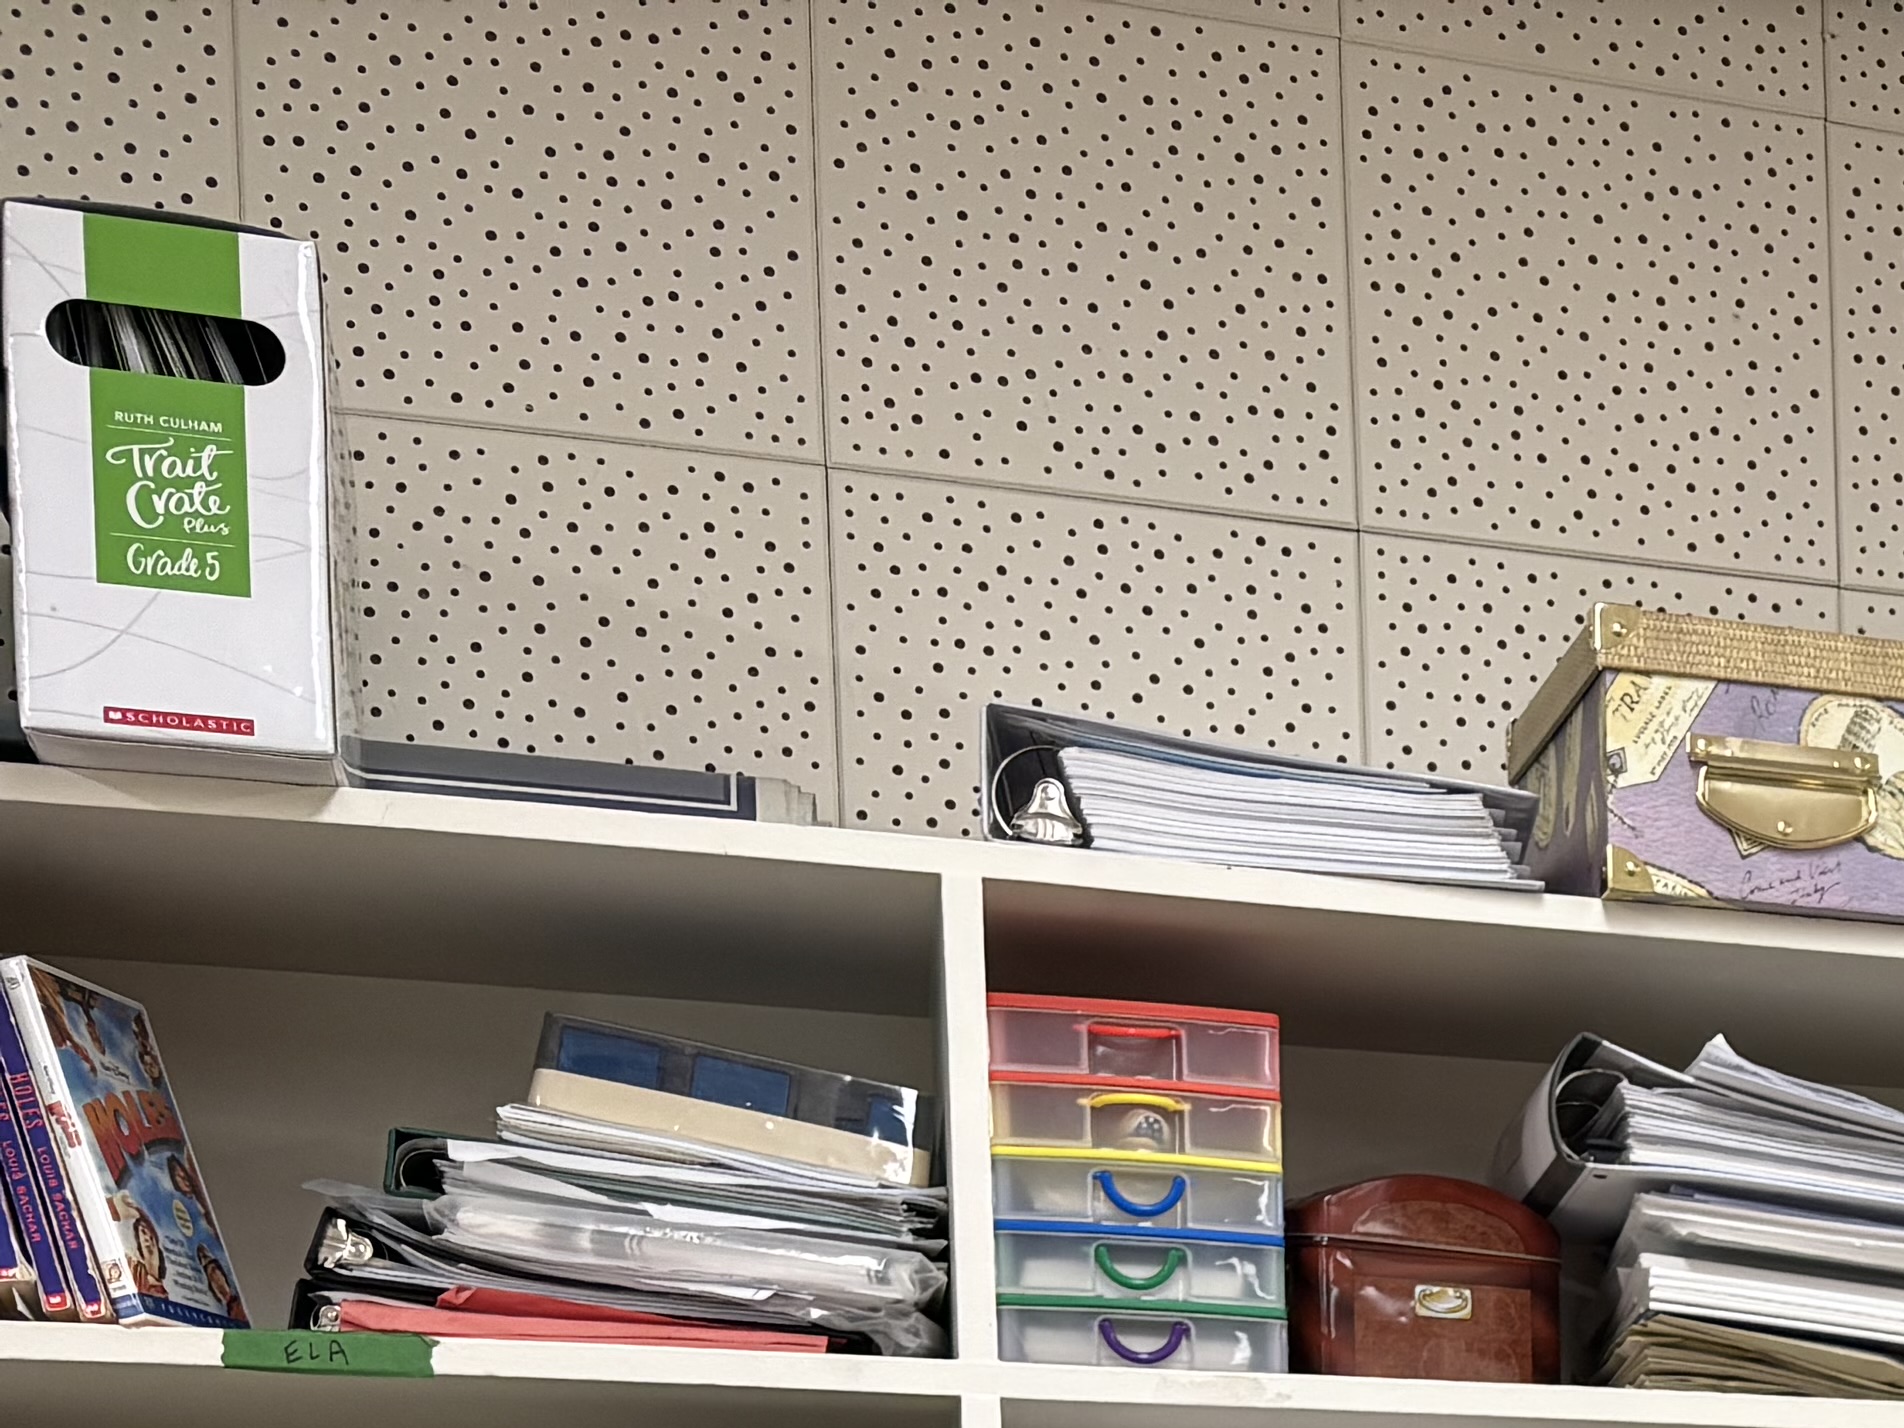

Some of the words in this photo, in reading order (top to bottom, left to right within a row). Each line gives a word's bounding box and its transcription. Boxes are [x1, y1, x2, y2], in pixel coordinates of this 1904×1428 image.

[114, 410, 154, 426] RUTH
[160, 416, 222, 433] CULHAM
[106, 437, 234, 481] Trait
[126, 482, 230, 529] Crate
[183, 518, 231, 536] Plus
[126, 541, 201, 577] Grade
[205, 552, 220, 579] 5
[125, 710, 252, 734] SCHOLASTIC
[9, 1072, 47, 1130] HOLES
[83, 1088, 184, 1190] HOLES
[14, 1184, 42, 1244] SACHAR
[37, 1146, 58, 1190] LOUIS
[53, 1191, 78, 1250] SACHAR
[284, 1339, 349, 1365] ELA
